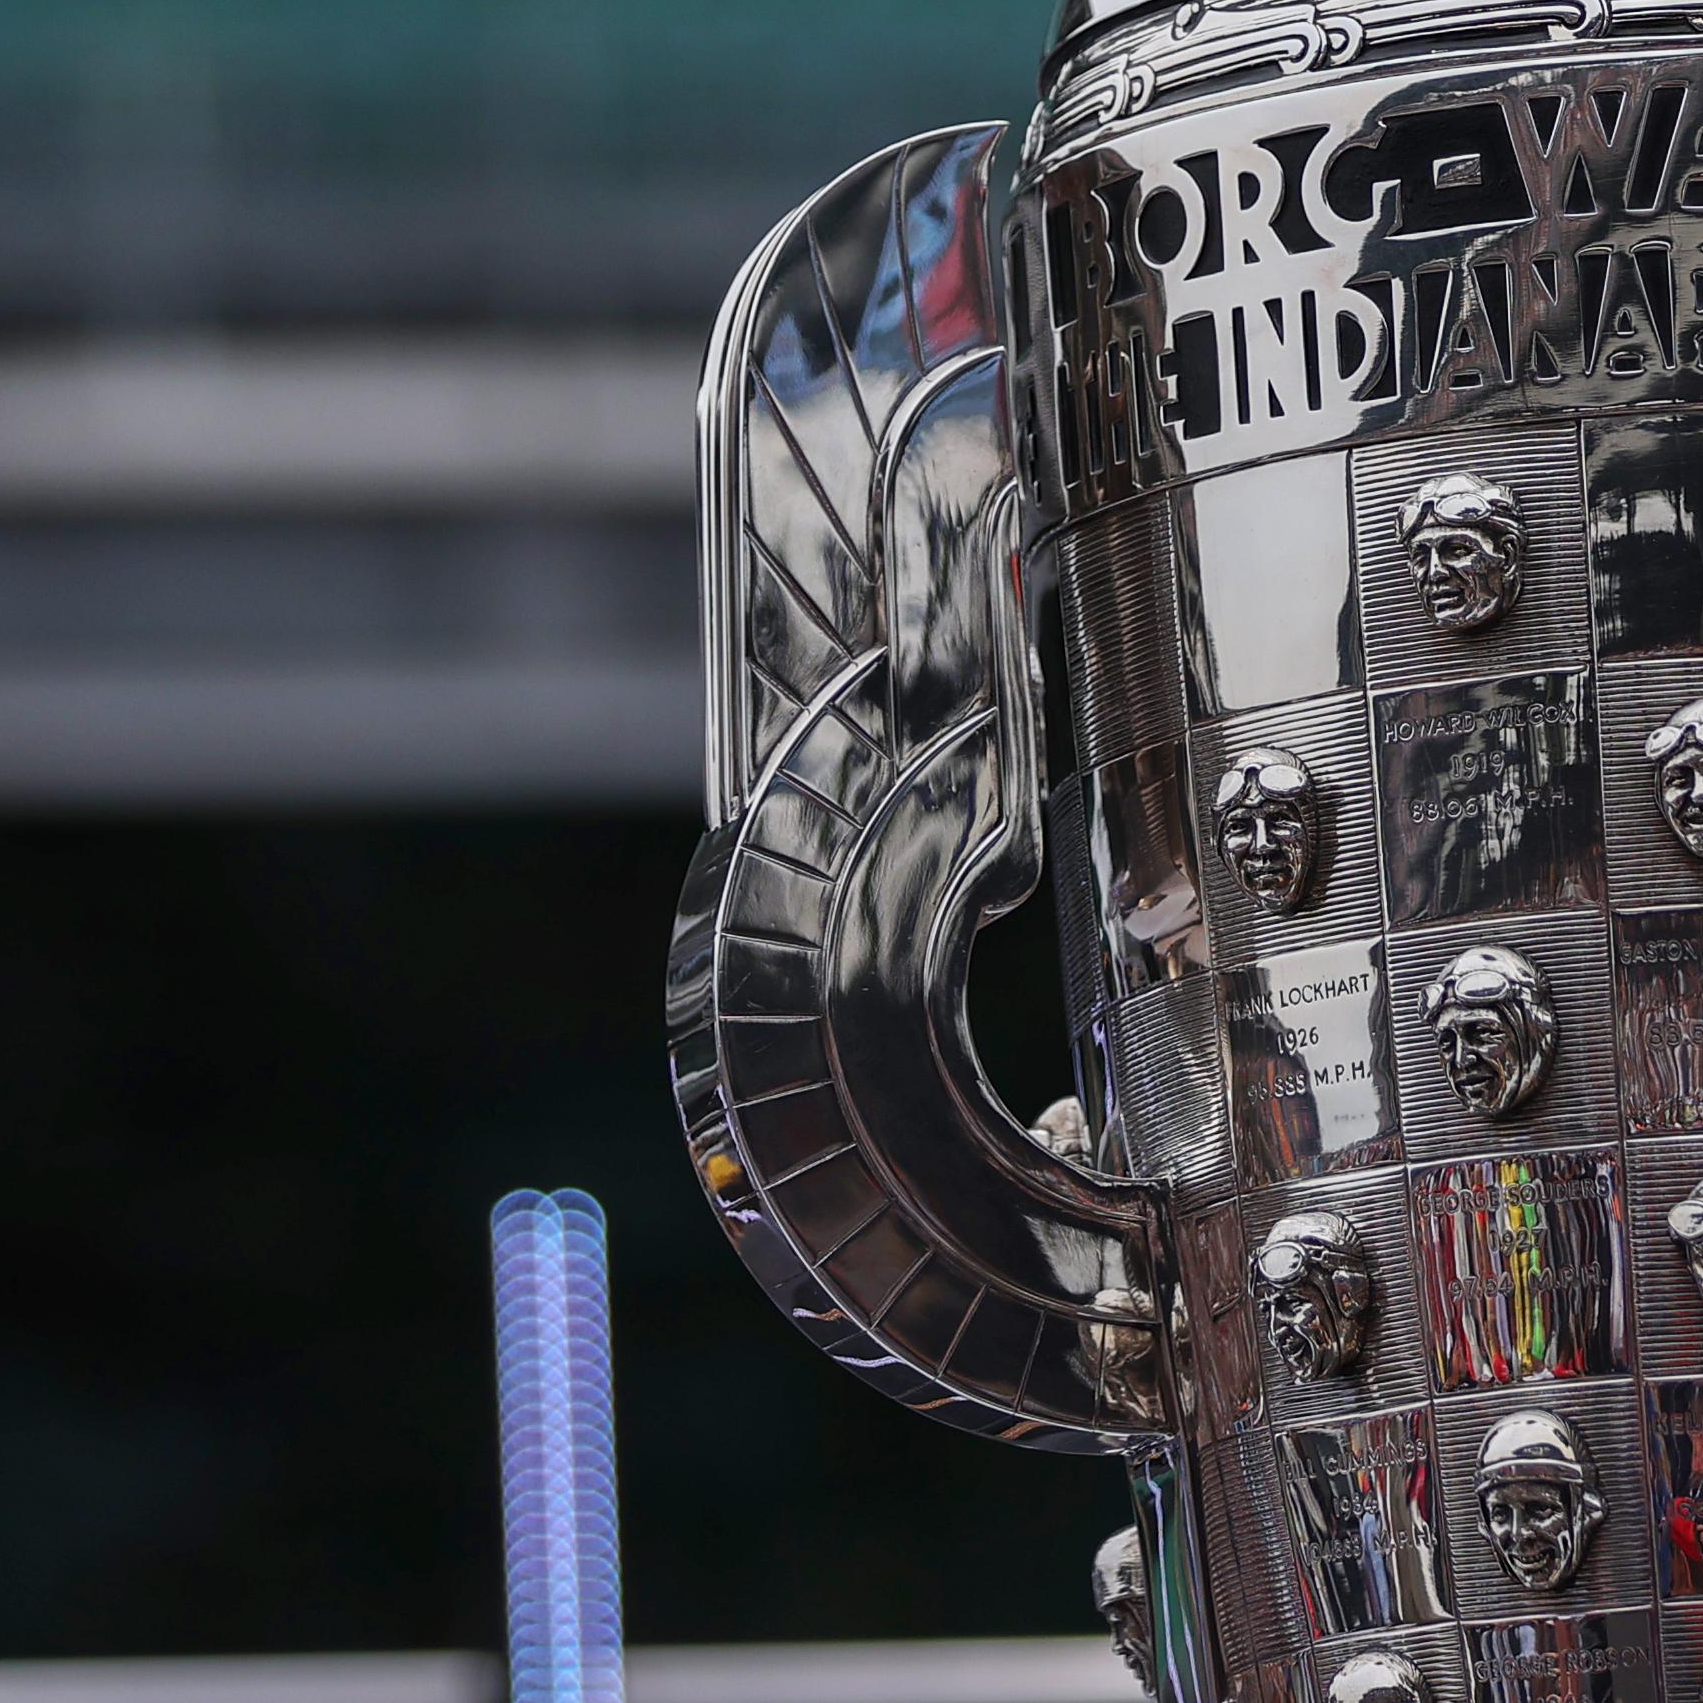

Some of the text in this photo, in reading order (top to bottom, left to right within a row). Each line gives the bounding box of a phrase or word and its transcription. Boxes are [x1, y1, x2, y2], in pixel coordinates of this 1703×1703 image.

[1383, 701, 1579, 744] HOWARD WILCOX
[1450, 749, 1506, 781] 1919
[1619, 936, 1698, 965] GASTON
[1224, 972, 1370, 1022] FRANK LOCKHART
[1277, 1026, 1320, 1058] 1926
[1314, 1059, 1373, 1087] M.P.H.
[1417, 1175, 1613, 1217] GEORGE SOUDERS
[1489, 1225, 1548, 1256] 1927
[1326, 1437, 1429, 1477] CUMMINGS
